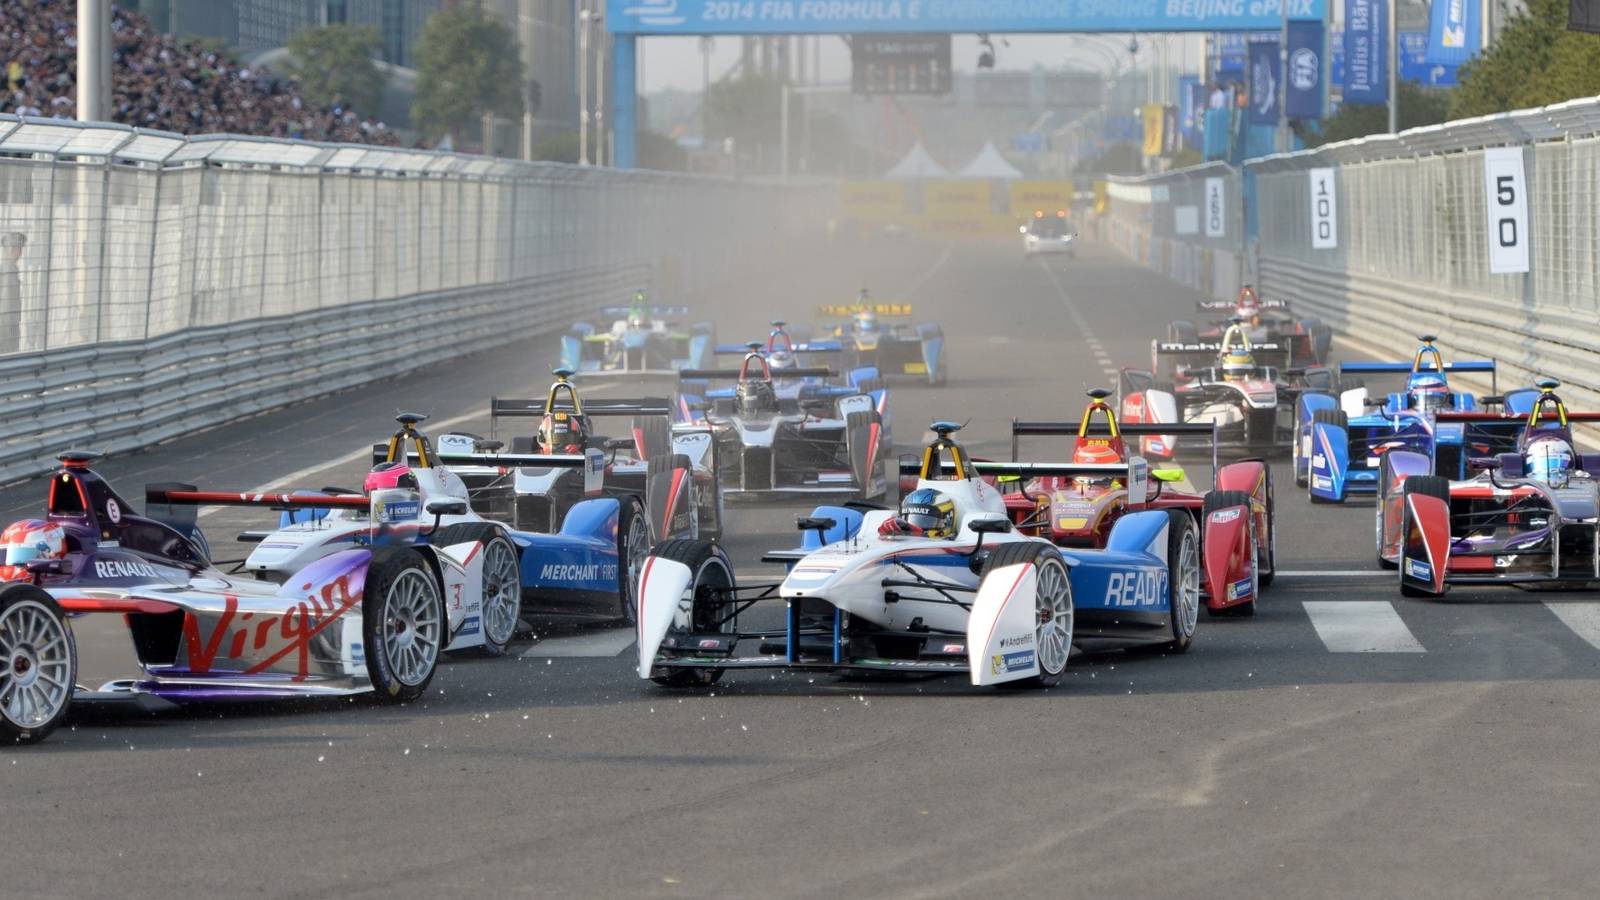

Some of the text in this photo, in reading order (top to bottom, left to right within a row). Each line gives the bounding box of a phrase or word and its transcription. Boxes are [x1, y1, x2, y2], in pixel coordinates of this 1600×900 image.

[702, 0, 753, 20] 2014
[760, 0, 796, 20] FIA
[800, 0, 900, 19] FORMULA
[908, 0, 922, 19] E
[1166, 0, 1244, 19] BEIJING
[1351, 37, 1370, 91] Julius
[1318, 179, 1331, 240] 100
[1496, 175, 1518, 247] 50
[540, 564, 599, 581] MERCHANT
[1104, 571, 1169, 607] READY?
[183, 568, 364, 683] Virgin
